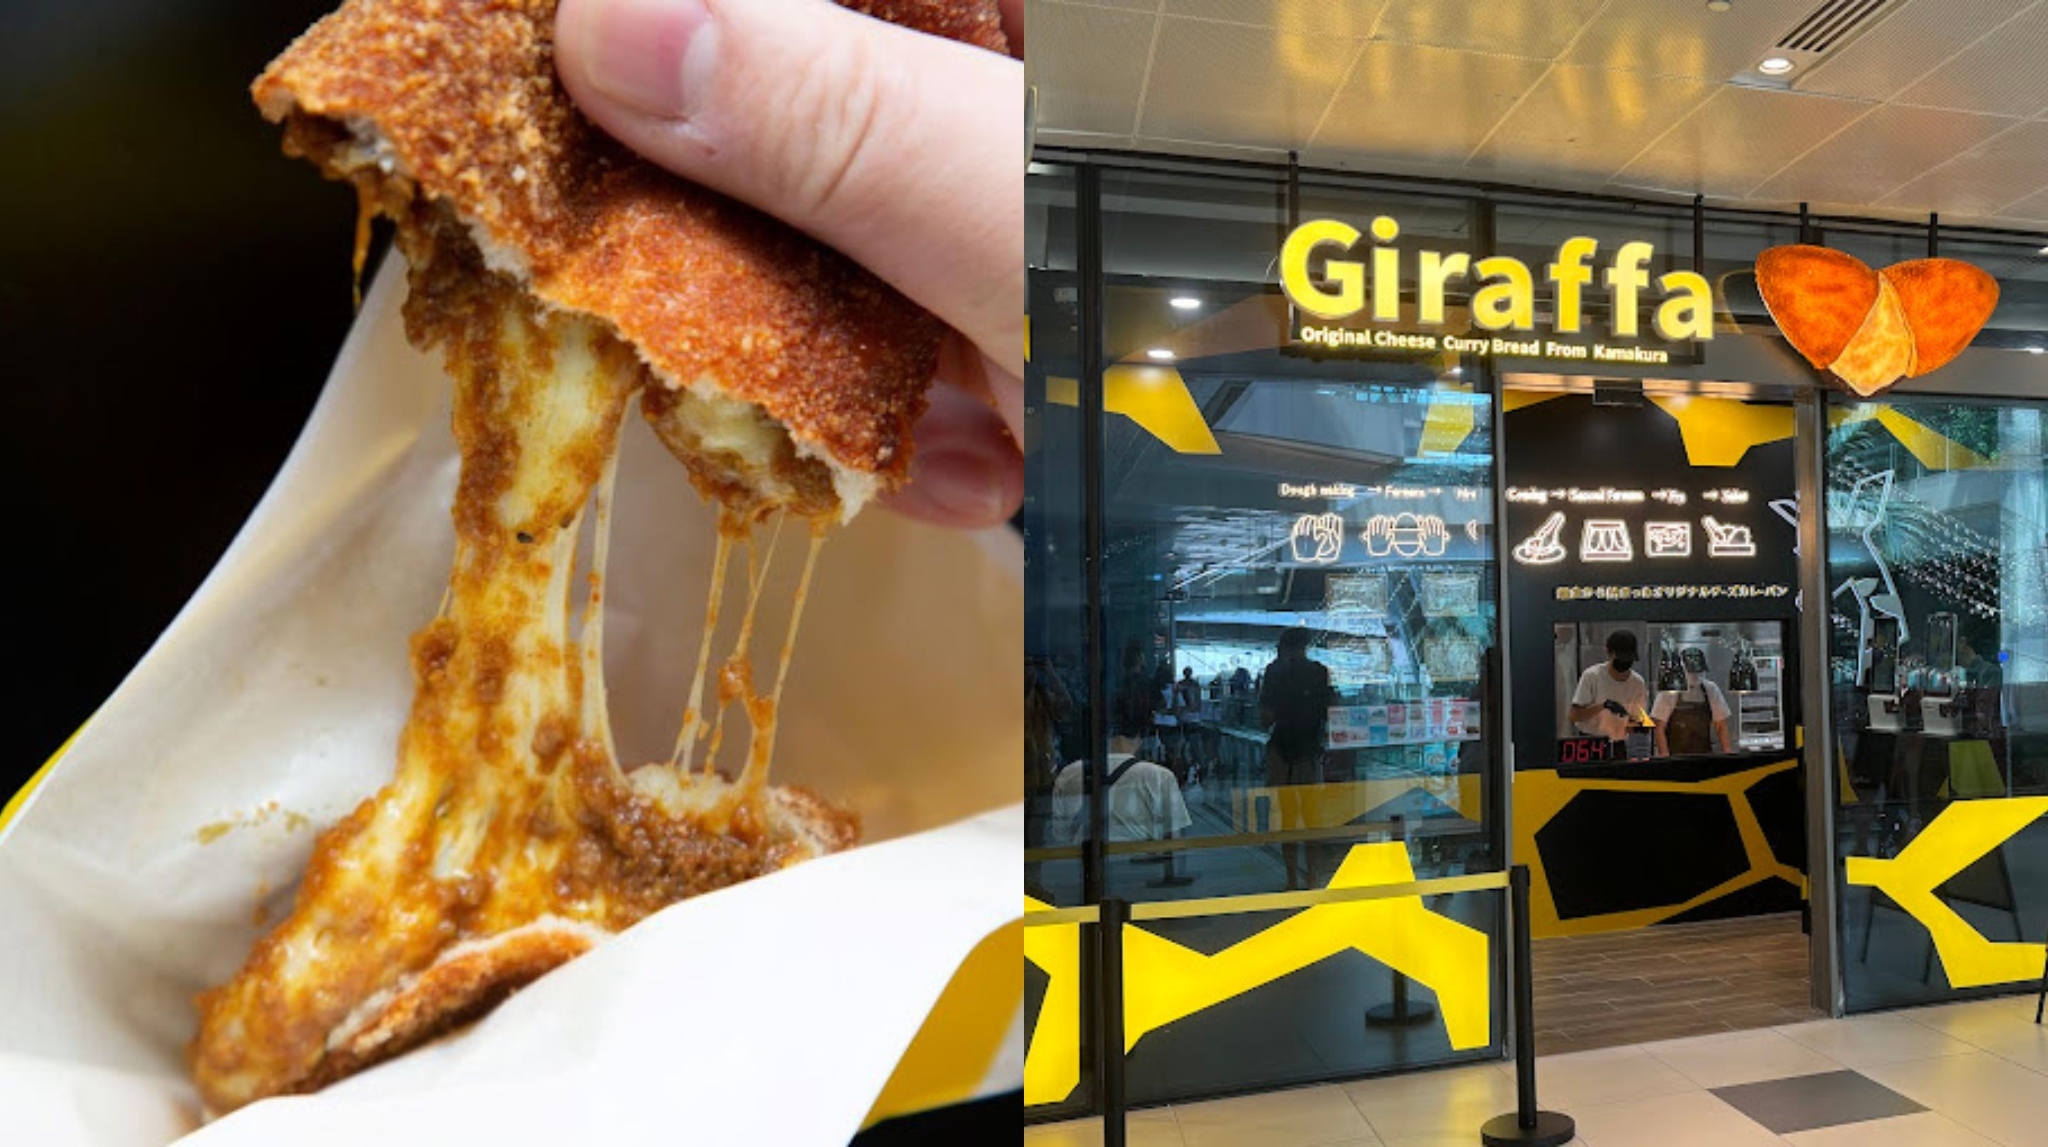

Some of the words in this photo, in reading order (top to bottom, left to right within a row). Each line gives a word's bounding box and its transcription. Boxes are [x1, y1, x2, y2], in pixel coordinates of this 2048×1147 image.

[1280, 215, 1715, 342] Giraffa
[1301, 326, 1371, 347] Original
[1374, 332, 1436, 350] Cheese
[1443, 335, 1490, 355] Curry
[1493, 338, 1540, 356] Bread
[1546, 341, 1587, 358] From
[1593, 343, 1669, 363] Kamakura
[1562, 740, 1606, 763] 064
